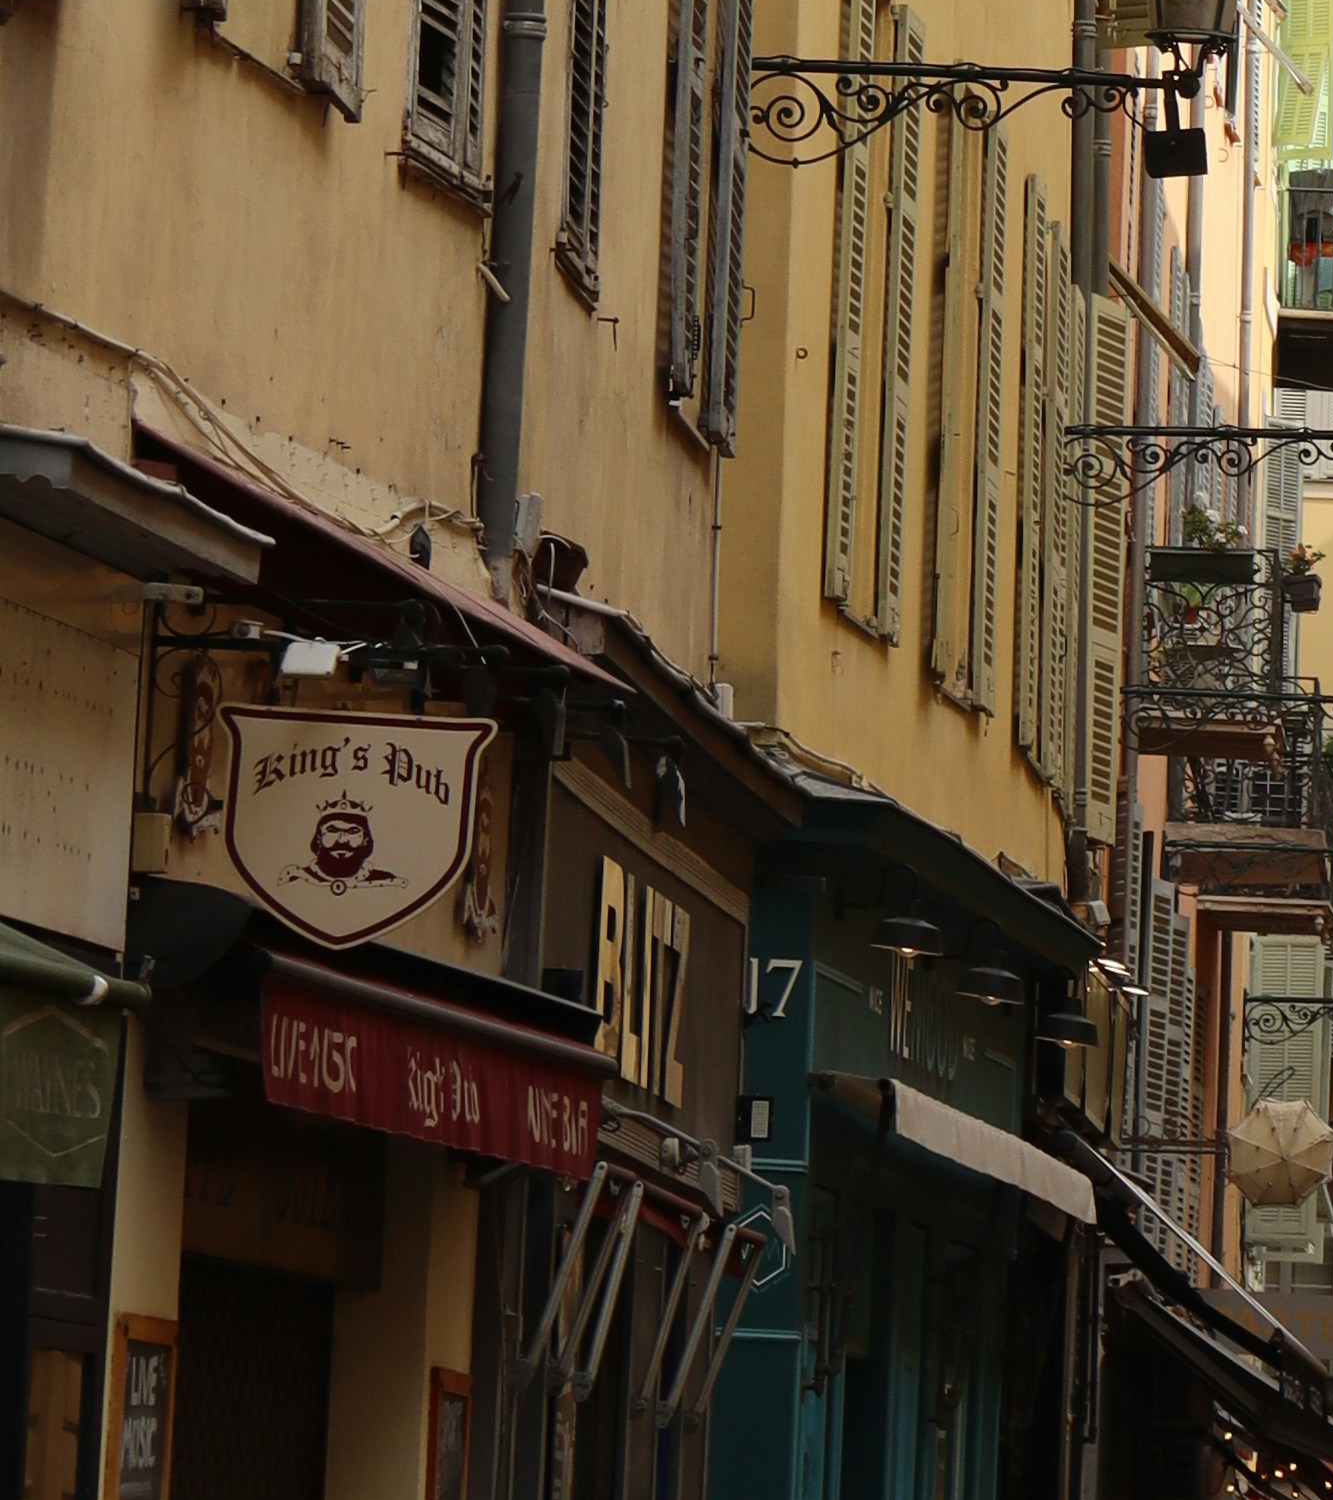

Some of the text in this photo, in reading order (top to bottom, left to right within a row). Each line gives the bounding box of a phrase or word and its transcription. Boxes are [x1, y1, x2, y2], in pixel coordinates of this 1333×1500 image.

[253, 737, 450, 806] King's Pub
[594, 855, 691, 1109] BLITZ
[270, 1014, 307, 1083] LIVE
[130, 1355, 158, 1407] LIVE
